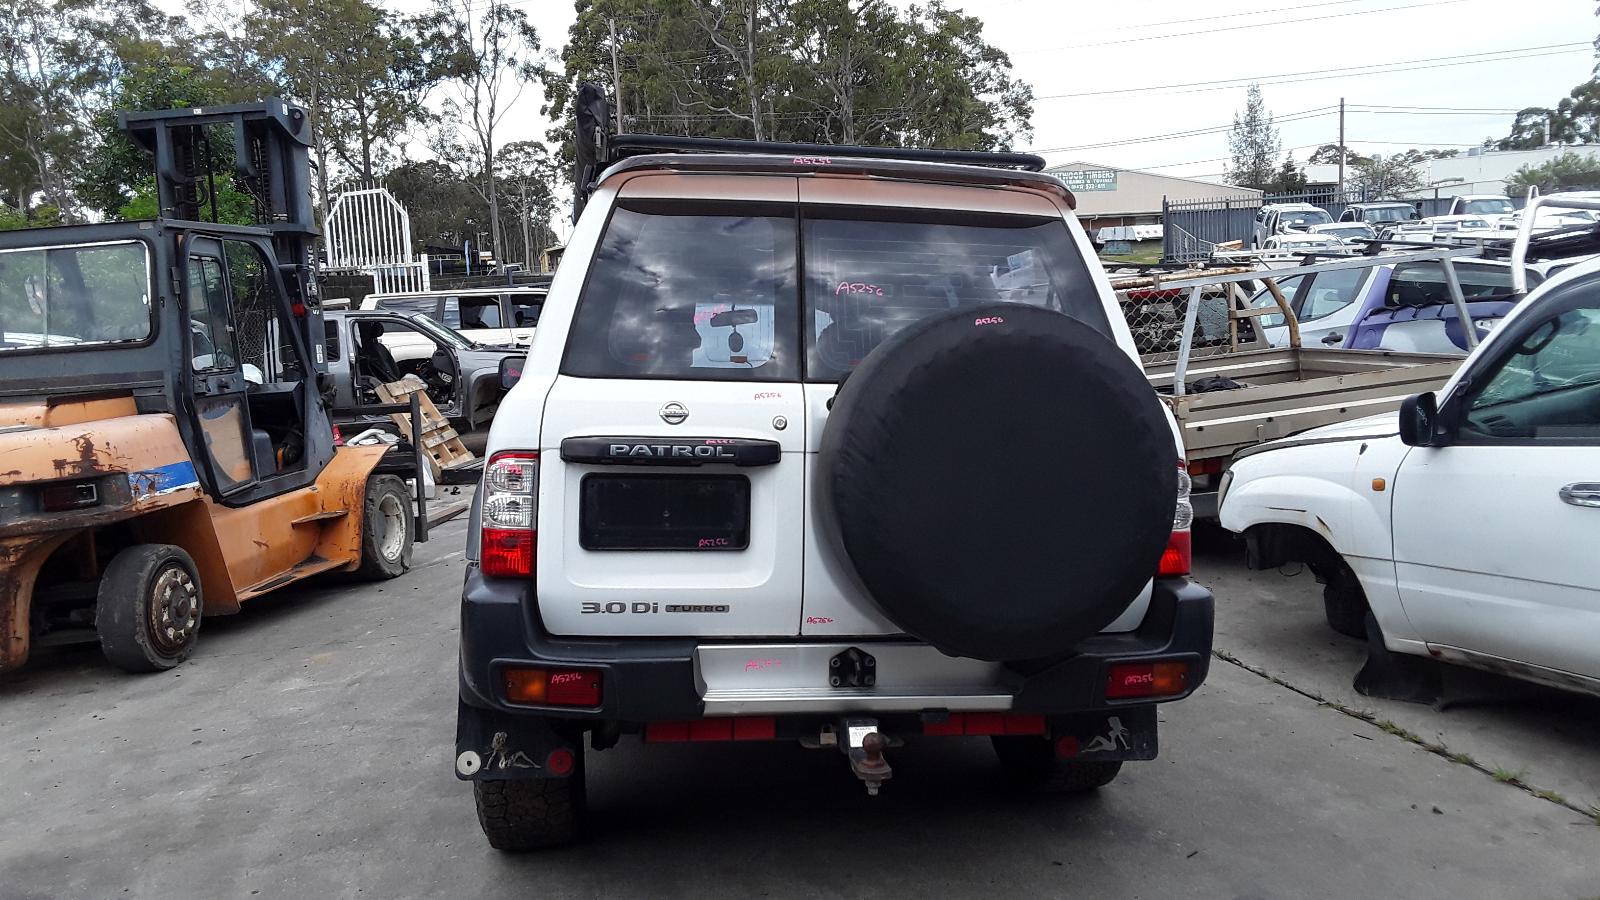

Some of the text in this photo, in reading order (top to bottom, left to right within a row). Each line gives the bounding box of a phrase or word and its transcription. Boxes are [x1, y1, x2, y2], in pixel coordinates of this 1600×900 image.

[1046, 171, 1115, 180] EETWOOD TIMBERS
[835, 281, 883, 296] A5256
[609, 444, 735, 457] PATROL
[580, 601, 627, 614] 3.0
[631, 601, 659, 614] Di
[551, 672, 582, 684] A5256
